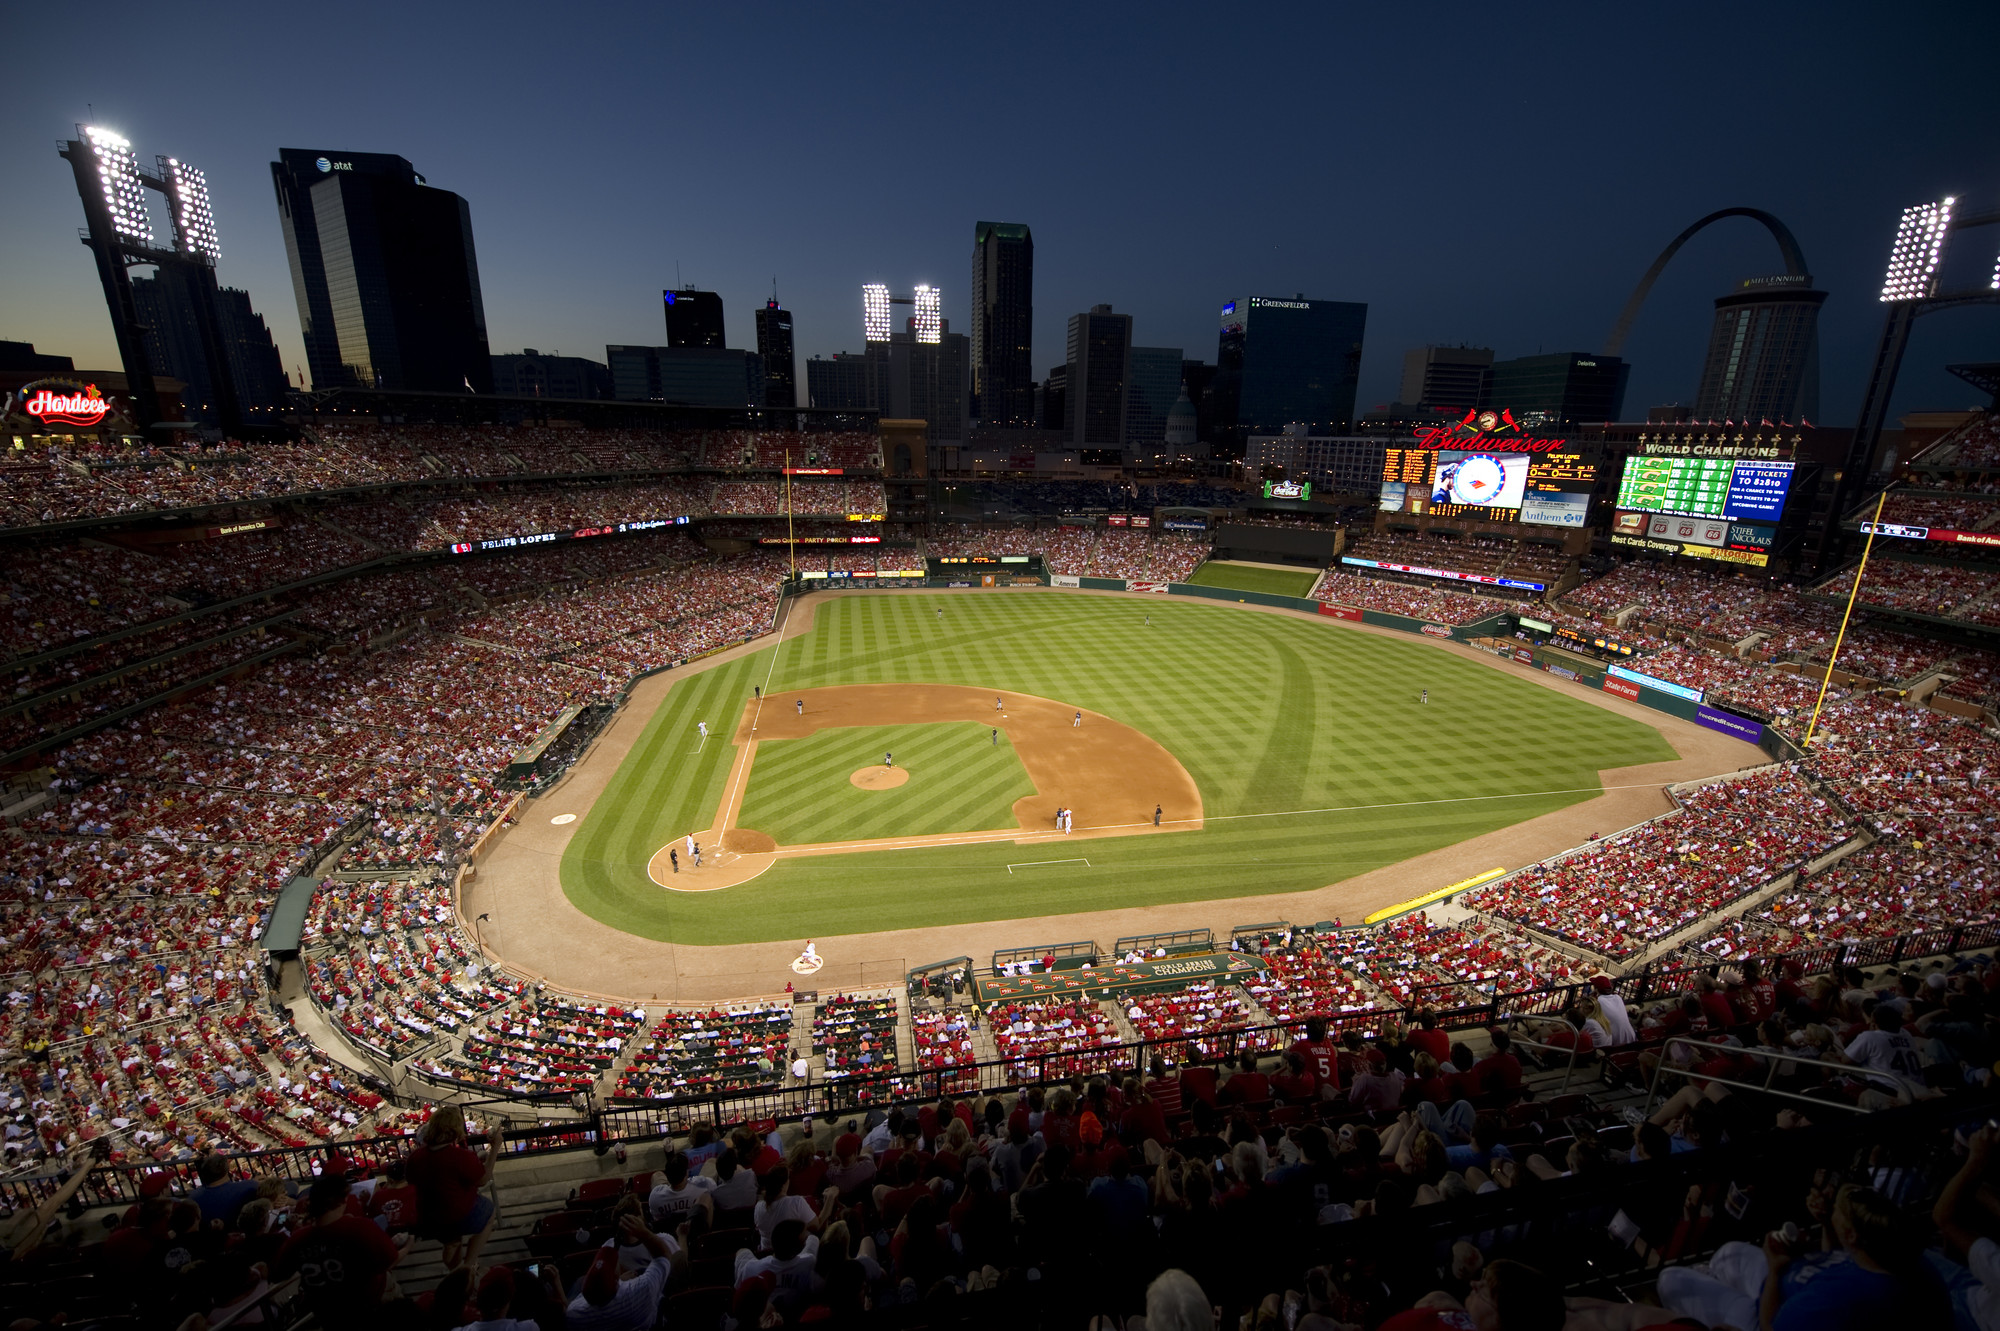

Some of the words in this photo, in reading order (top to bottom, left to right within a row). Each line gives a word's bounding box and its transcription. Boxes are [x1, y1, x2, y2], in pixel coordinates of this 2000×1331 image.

[333, 161, 353, 170] at&t
[1751, 275, 1804, 284] MILLENNIUM
[1261, 299, 1310, 309] GREENSFELDER
[1413, 427, 1566, 452] Budweiser
[1646, 443, 1690, 454] WORLD
[1693, 445, 1780, 457] CHAMPIONS
[1739, 477, 1751, 485] TO
[1753, 478, 1781, 487] 82810
[1523, 511, 1561, 522] Anthem
[1679, 527, 1691, 535] 66
[1707, 530, 1719, 538] 66
[1731, 525, 1755, 535] STIFEL
[481, 537, 517, 549] FELIPE
[520, 533, 556, 545] LOPEZ
[1611, 535, 1627, 544] Best
[1627, 537, 1646, 547] Cards
[1647, 540, 1679, 552] Coverage
[1731, 533, 1772, 546] NICOLAUS
[1956, 534, 1976, 542] Bank
[1409, 566, 1443, 577] SCOREBOARD
[1443, 571, 1460, 579] PATIO
[1604, 680, 1622, 692] State
[1620, 685, 1638, 697] Farm
[1698, 711, 1758, 736] freecreditscore.com
[1152, 963, 1183, 971] WORLD
[1155, 964, 1217, 976] CHAMPIONS
[1763, 992, 1771, 1005] 5
[1310, 1047, 1331, 1055] PUJOLS
[1318, 1058, 1330, 1078] 5
[301, 1258, 345, 1287] 28
